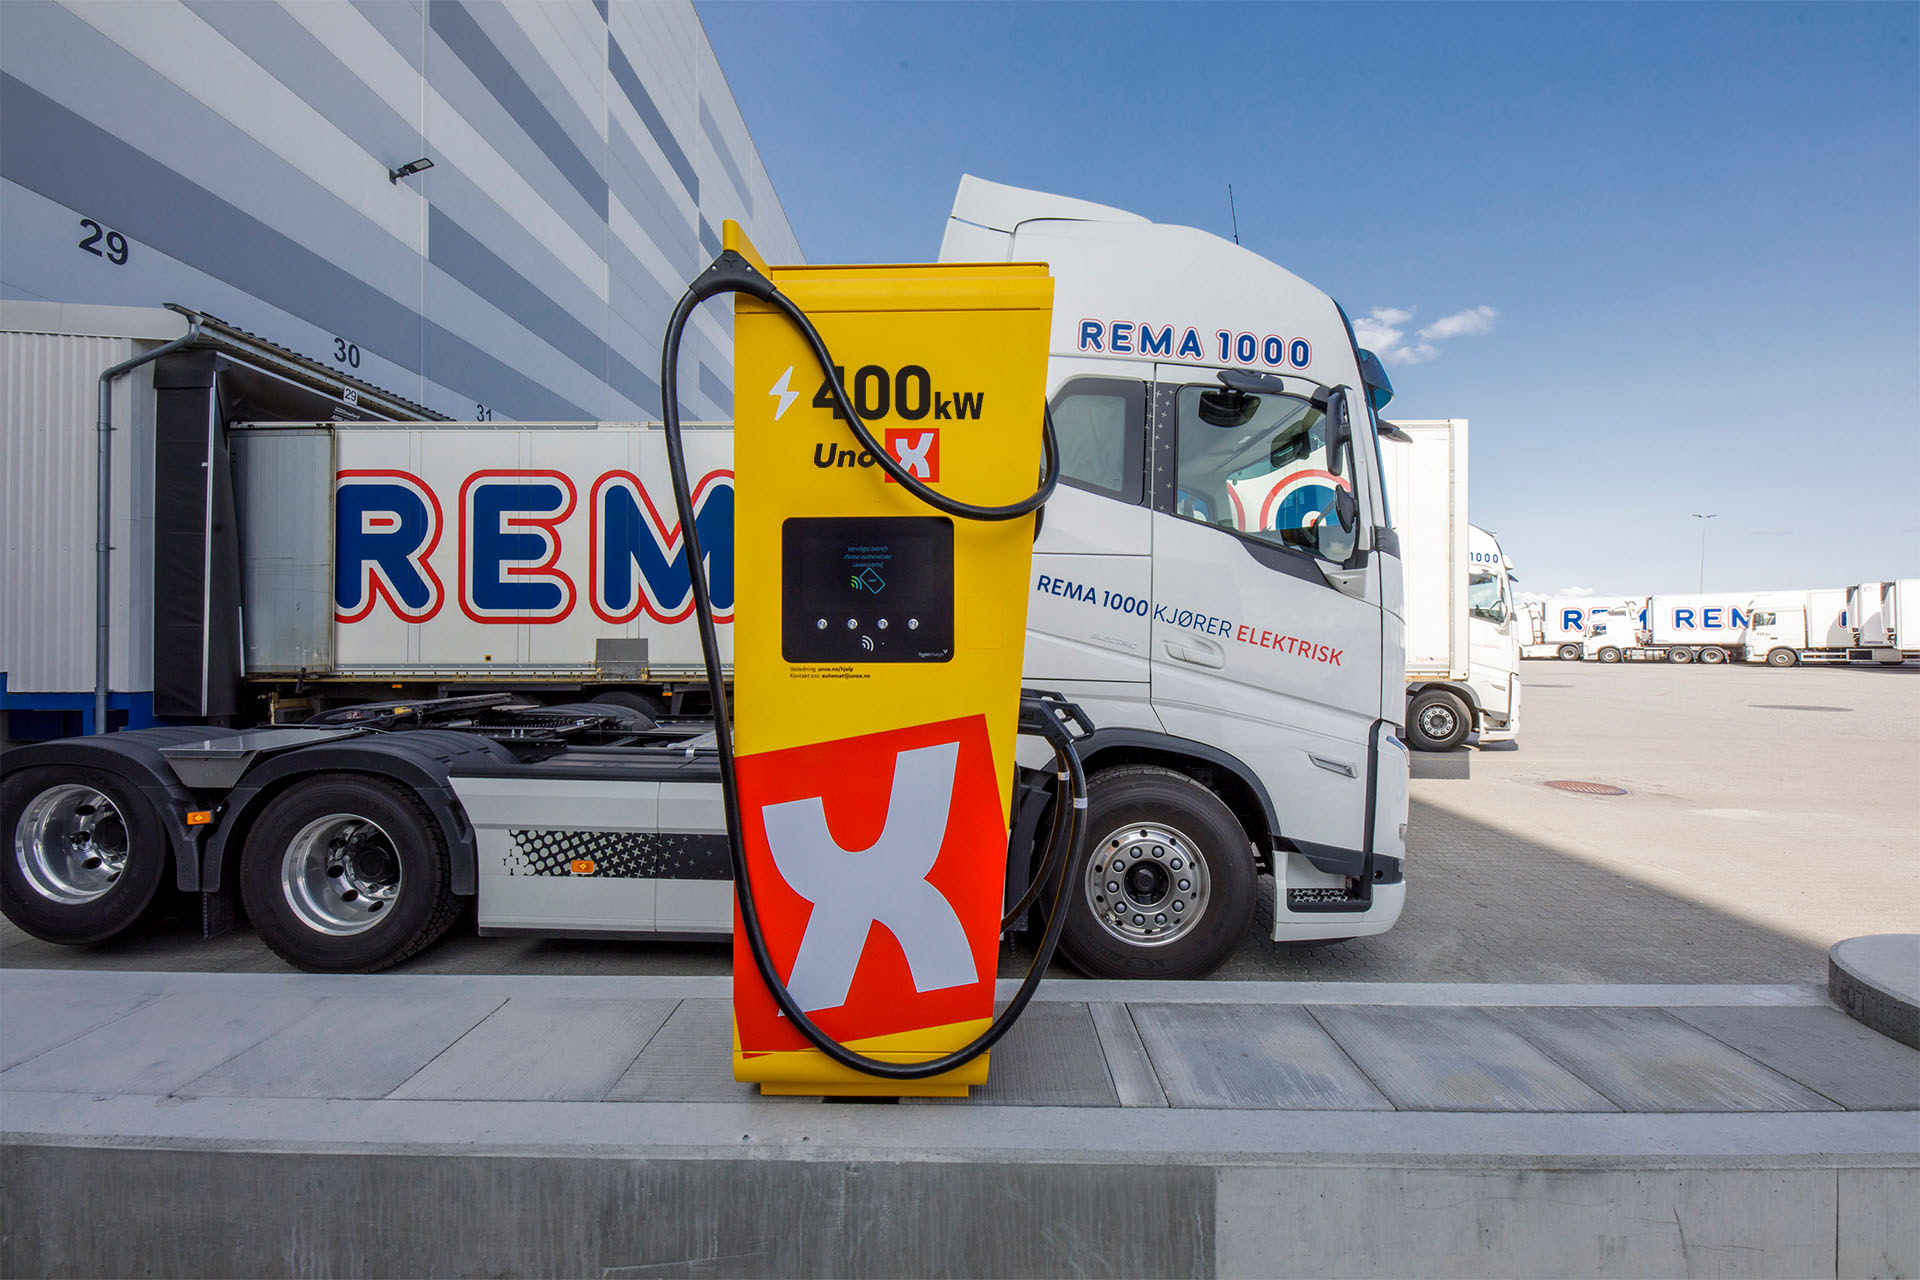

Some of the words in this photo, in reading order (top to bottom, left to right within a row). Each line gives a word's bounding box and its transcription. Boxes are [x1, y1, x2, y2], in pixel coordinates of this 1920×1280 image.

[79, 219, 128, 265] 29
[334, 337, 360, 368] 30
[1078, 318, 1204, 360] REMA
[1216, 329, 1312, 370] 1000
[345, 388, 357, 401] 29
[476, 404, 492, 422] 31
[814, 443, 876, 468] Uno
[1470, 552, 1499, 563] 1000
[1037, 575, 1096, 604] REMA
[1103, 590, 1149, 616] 1000
[1153, 604, 1232, 638] KJØRER
[1236, 625, 1344, 667] ELEKTRISK
